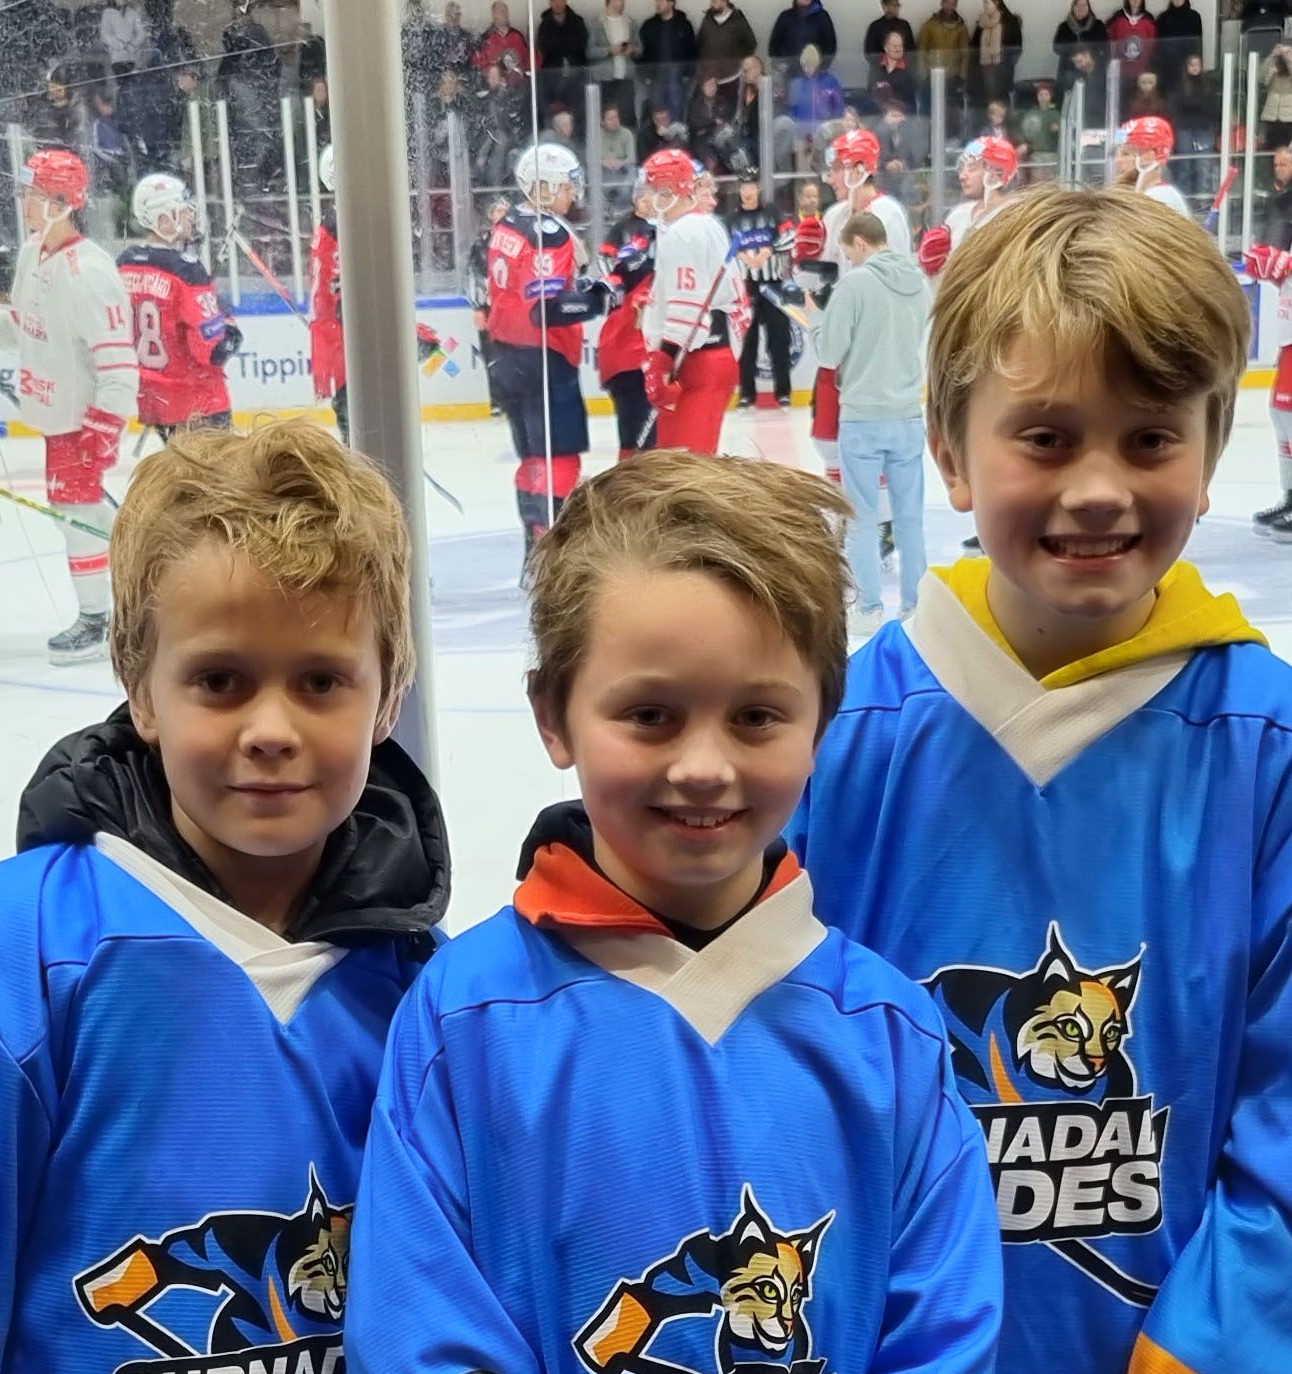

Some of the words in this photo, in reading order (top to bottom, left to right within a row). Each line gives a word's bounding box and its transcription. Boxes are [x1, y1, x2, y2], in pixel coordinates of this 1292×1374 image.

[675, 266, 697, 291] 15
[238, 351, 312, 384] Tippi
[995, 1162, 1160, 1233] DES
